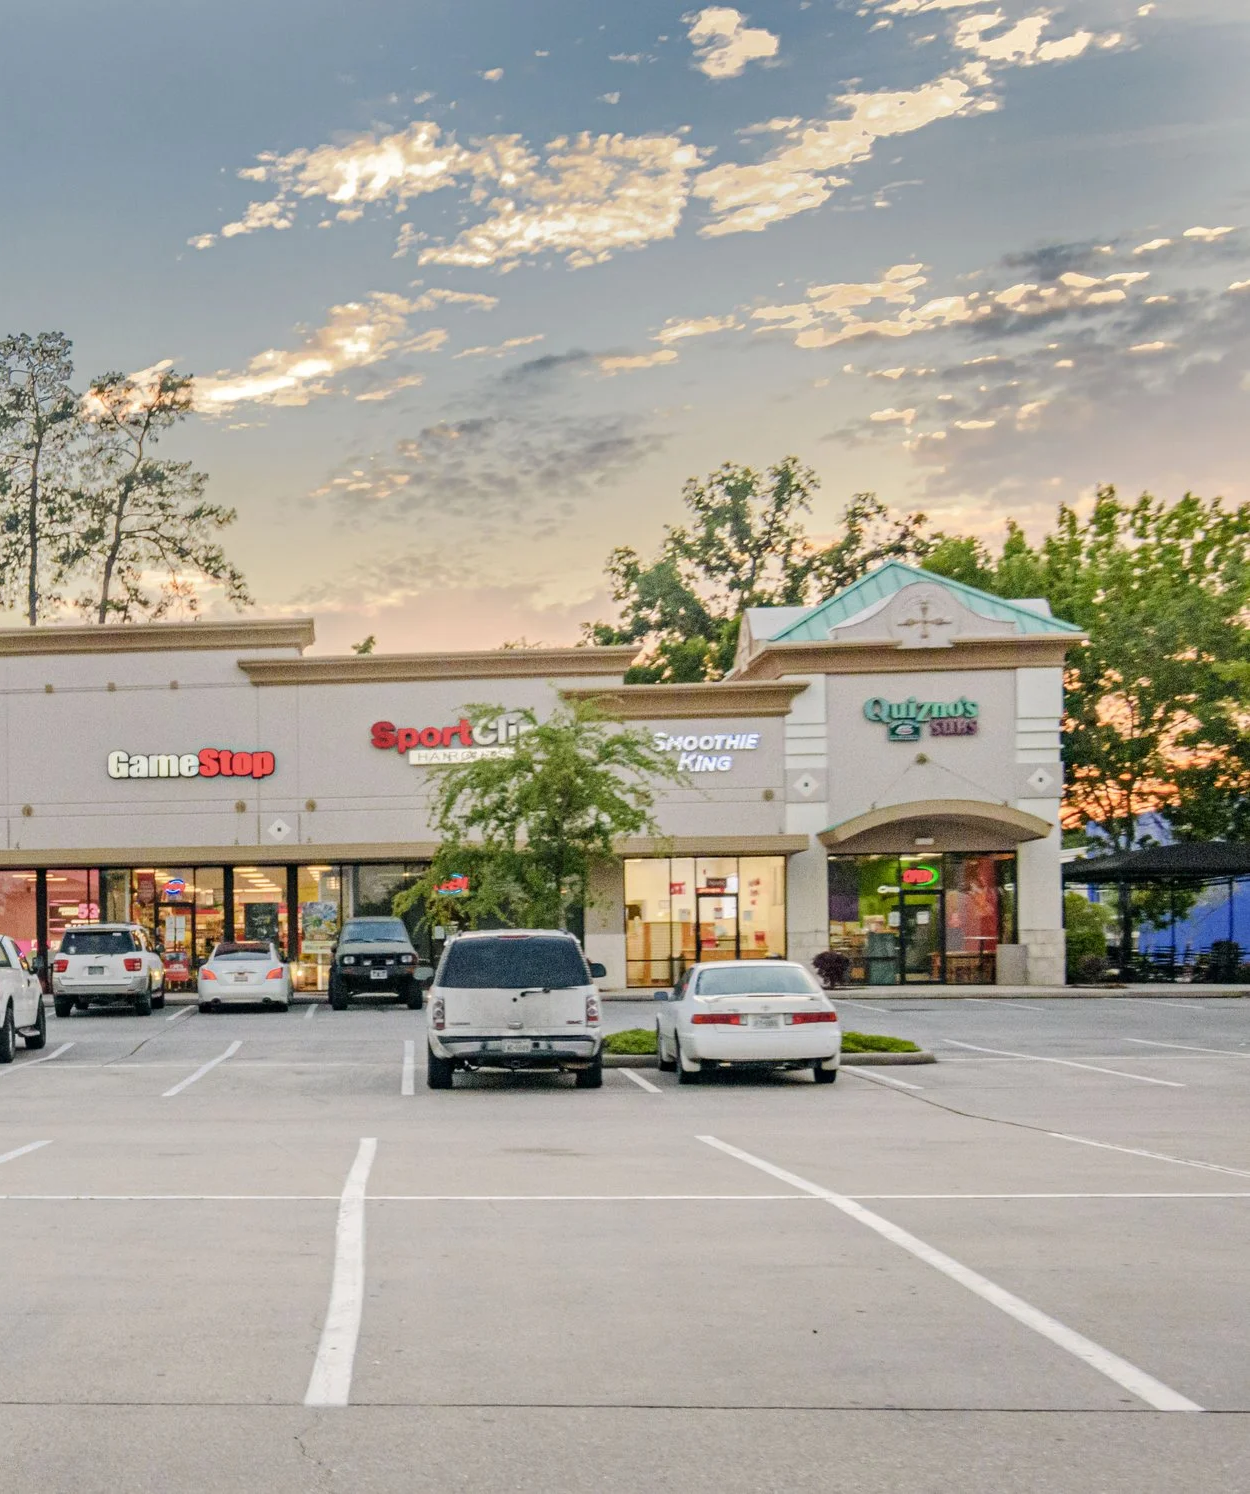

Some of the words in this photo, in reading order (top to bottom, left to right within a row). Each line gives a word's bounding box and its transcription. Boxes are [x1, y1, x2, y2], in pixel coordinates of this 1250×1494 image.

[863, 696, 979, 724] Quizno's
[652, 732, 760, 752] SMOOTHIE
[107, 748, 276, 779] GameStop
[677, 752, 734, 772] KING
